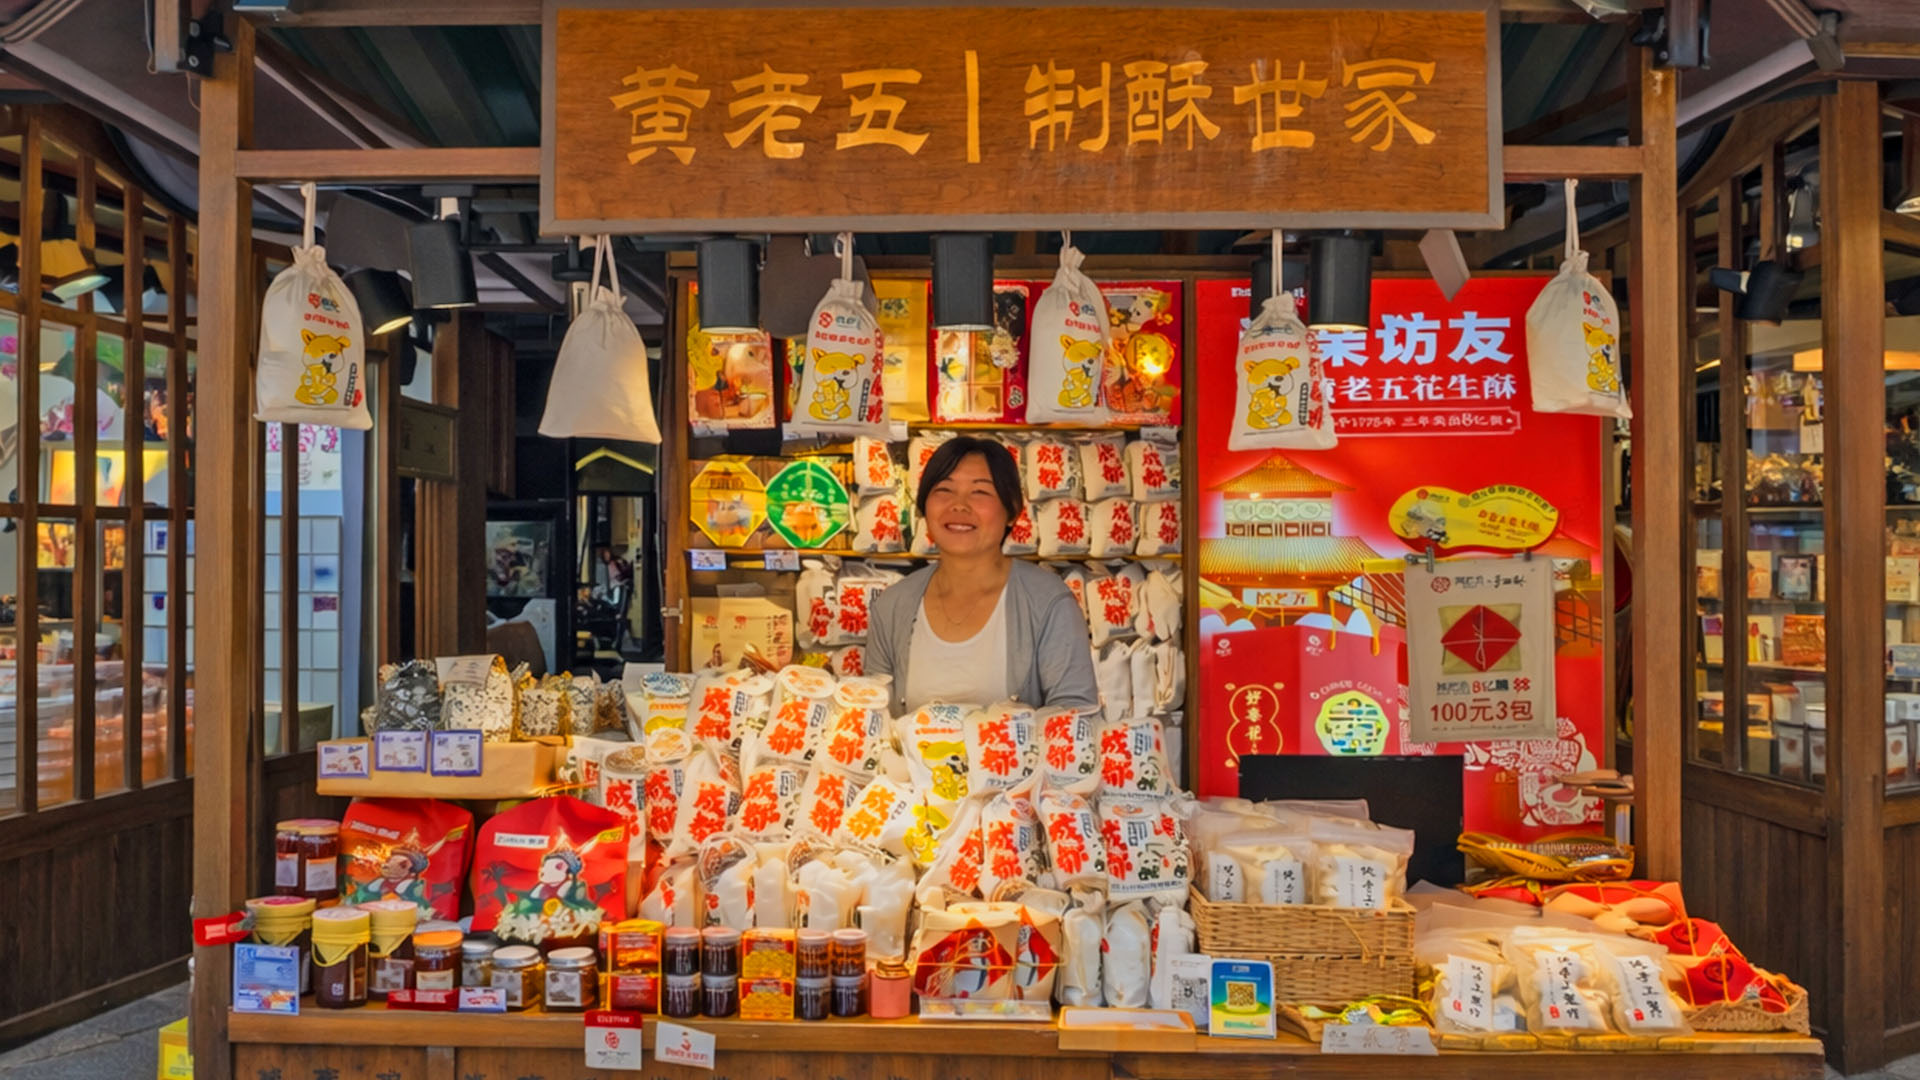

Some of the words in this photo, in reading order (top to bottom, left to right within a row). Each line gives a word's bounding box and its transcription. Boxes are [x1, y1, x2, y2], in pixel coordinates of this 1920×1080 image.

[610, 64, 931, 165] 黄老五
[1024, 58, 1437, 154] 制酥世家
[1430, 697, 1534, 722] 100元3包
